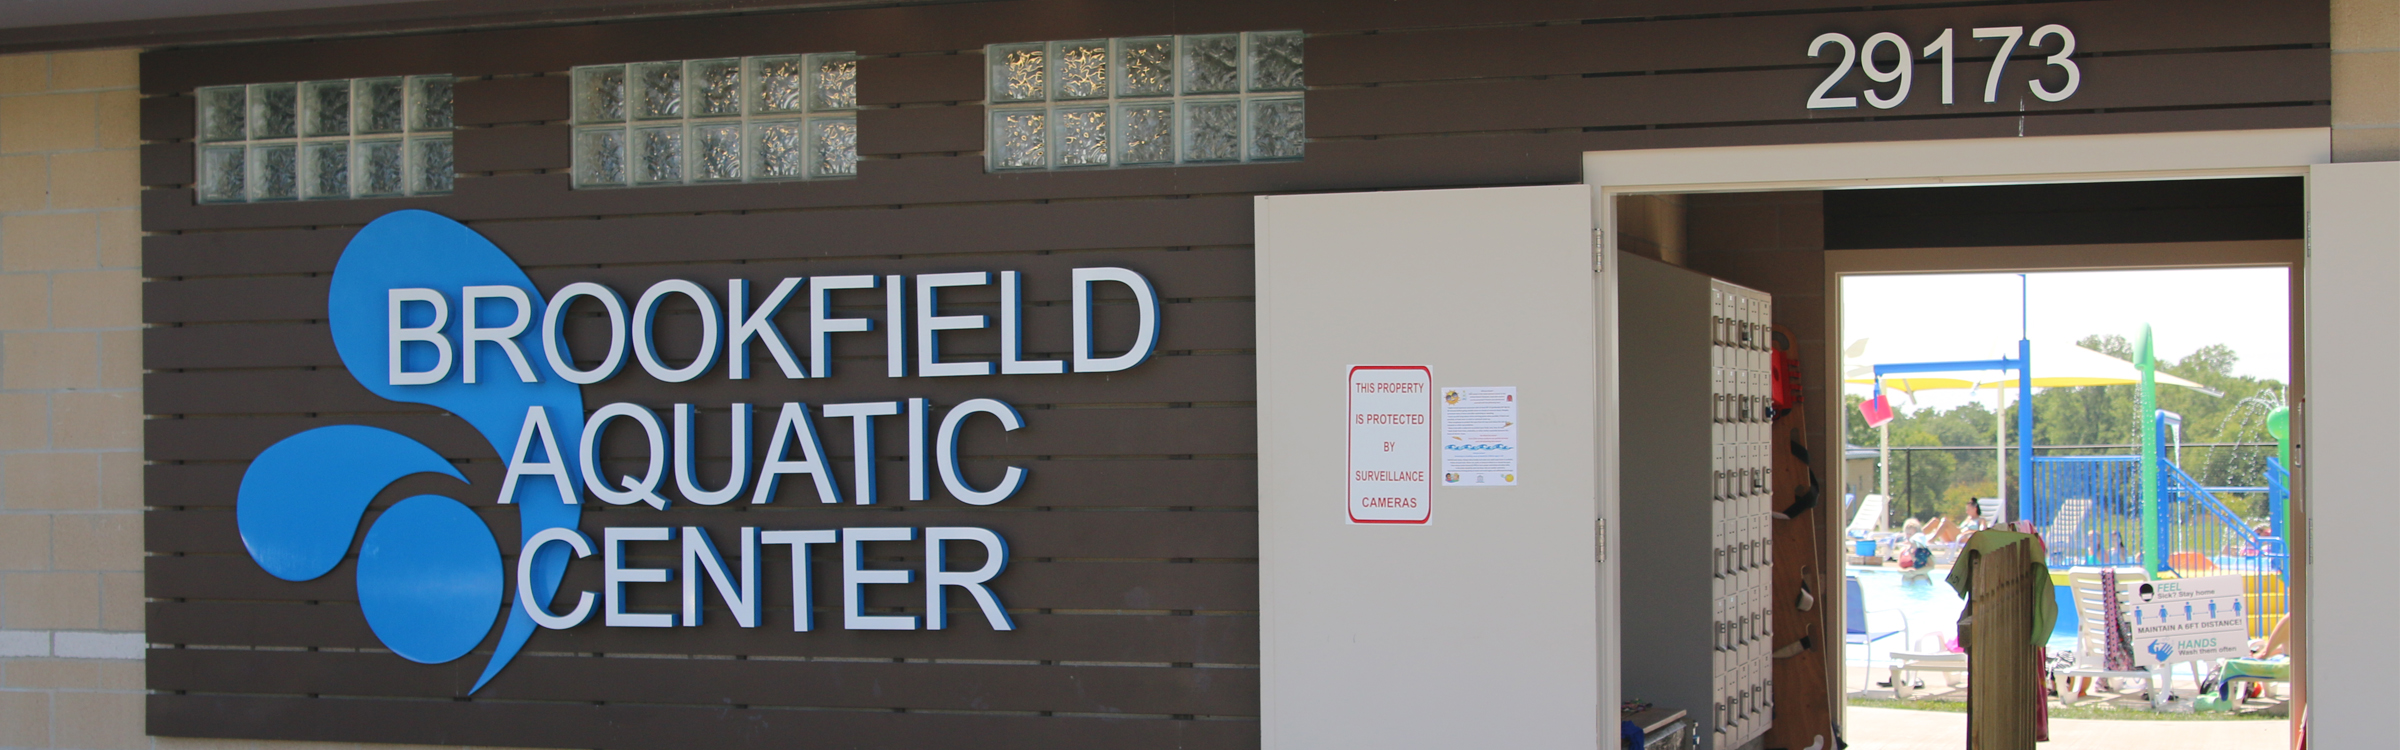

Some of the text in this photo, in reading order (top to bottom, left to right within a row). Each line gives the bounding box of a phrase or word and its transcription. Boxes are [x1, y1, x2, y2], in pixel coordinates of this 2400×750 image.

[1806, 24, 2081, 109] 29173
[387, 267, 1159, 387] BROOKFIELD
[1356, 382, 1425, 394] THIS PROPERTY
[1356, 414, 1424, 425] IS PROTECTED
[1384, 441, 1395, 452] BY
[497, 397, 1026, 512] AQUATIC
[1355, 470, 1424, 482] SURVEILLANCE
[1362, 497, 1417, 508] CAMERAS
[516, 526, 1015, 632] CENTER
[2157, 582, 2181, 592] FEEL
[2157, 592, 2177, 600] Sick?
[2138, 625, 2175, 634] MAINTAIN
[2184, 622, 2199, 630] 6FT
[2201, 620, 2242, 629] DISTANCE!
[2178, 638, 2217, 649] HANDS
[2178, 648, 2198, 656] Wash
[2199, 647, 2217, 655] them
